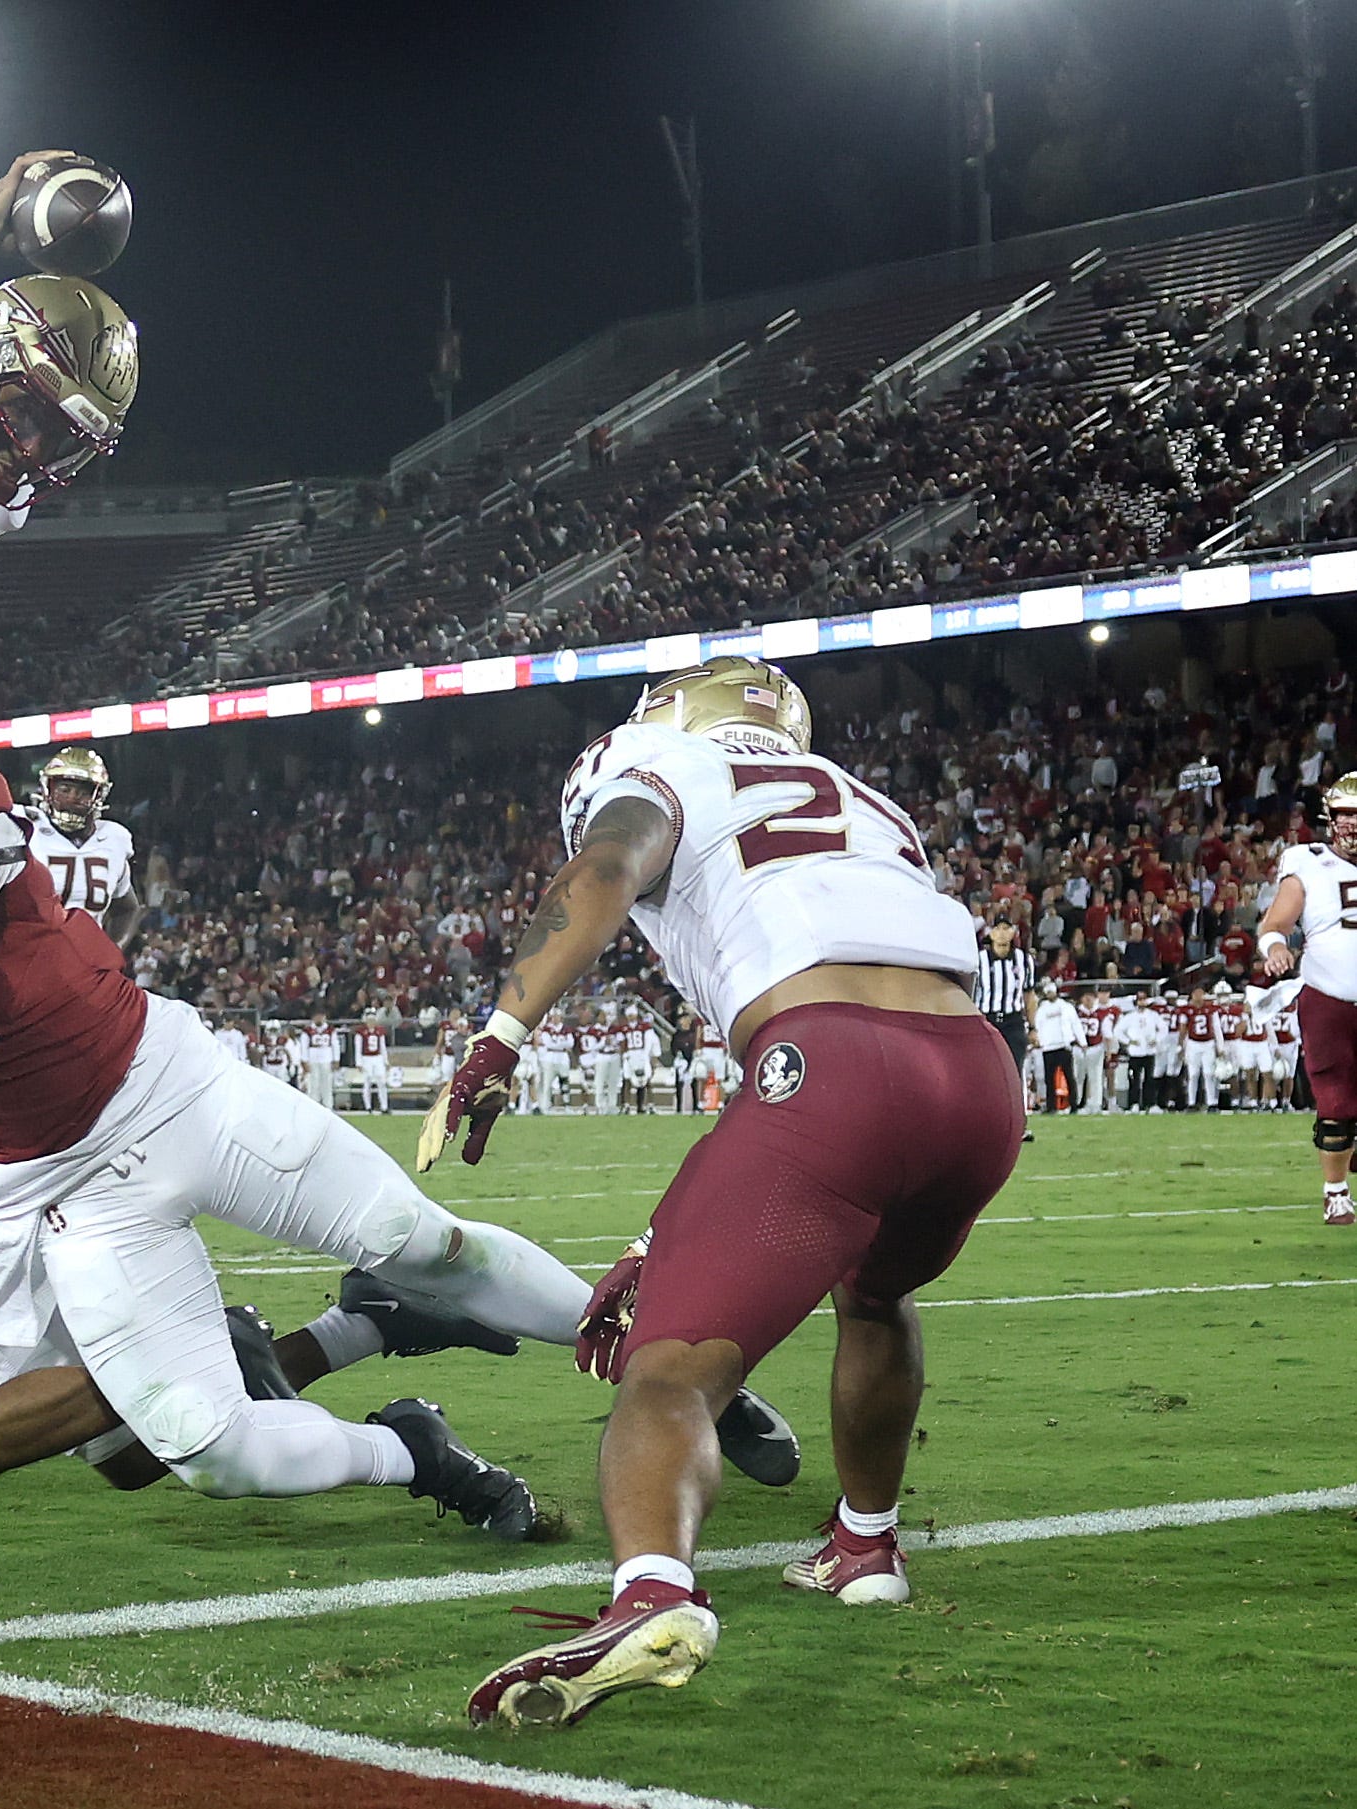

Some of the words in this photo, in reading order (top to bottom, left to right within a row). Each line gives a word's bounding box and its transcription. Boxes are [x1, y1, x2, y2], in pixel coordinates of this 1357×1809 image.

[723, 730, 785, 753] FLORIDA
[47, 855, 111, 912] 76
[1194, 1014, 1208, 1036] 2
[625, 1030, 642, 1048] 18
